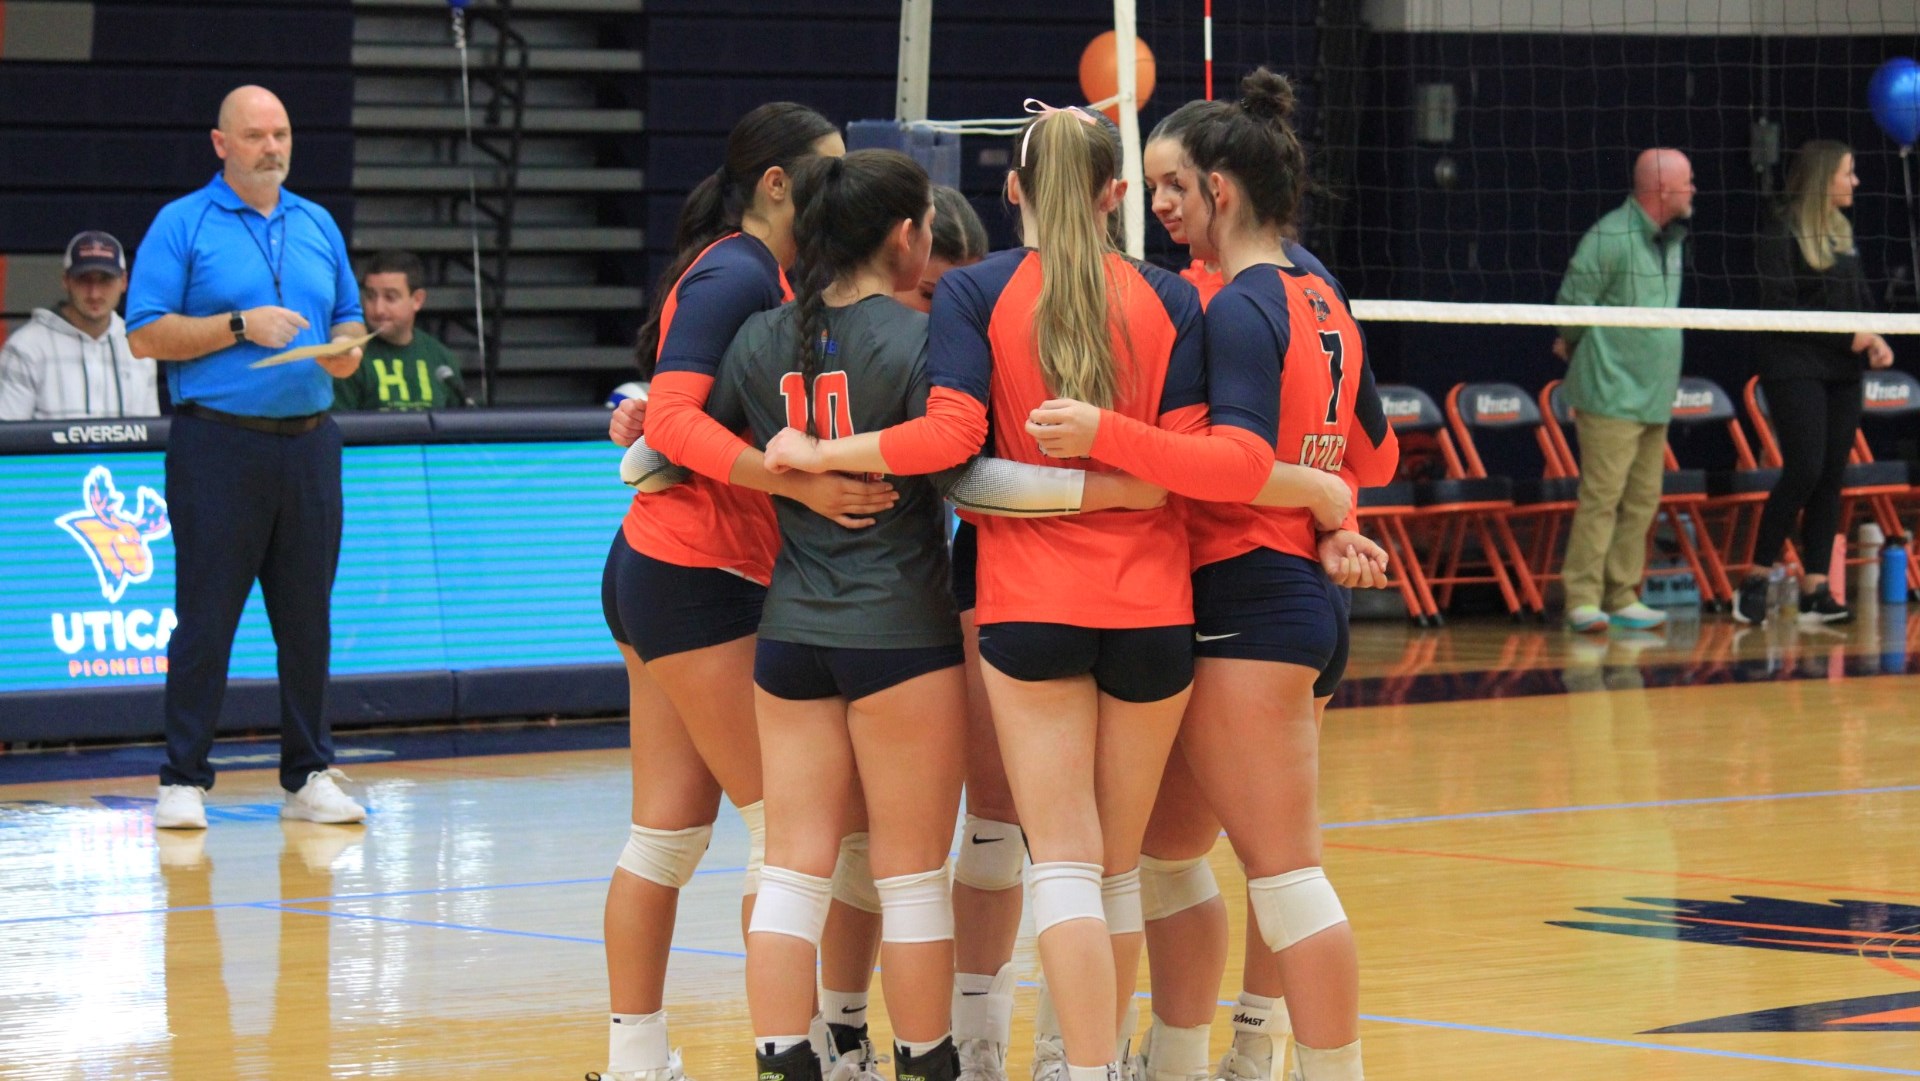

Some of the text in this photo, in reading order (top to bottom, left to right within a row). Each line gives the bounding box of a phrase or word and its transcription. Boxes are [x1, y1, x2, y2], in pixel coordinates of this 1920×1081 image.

[372, 358, 433, 402] HI
[1318, 329, 1344, 425] 7
[780, 370, 854, 440] 10
[68, 424, 147, 443] EVERSAN
[51, 607, 179, 655] UTICA
